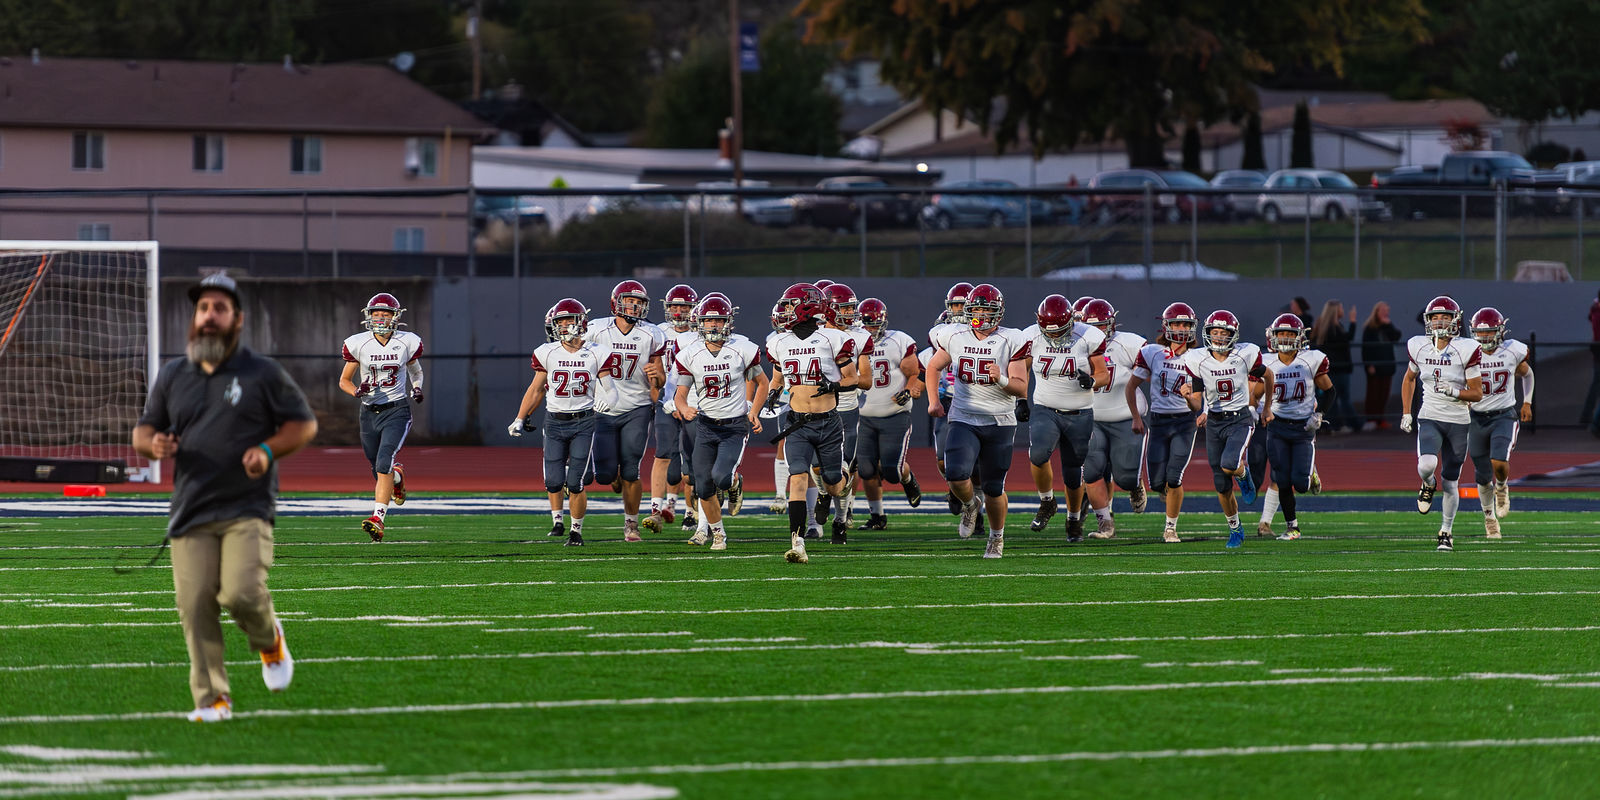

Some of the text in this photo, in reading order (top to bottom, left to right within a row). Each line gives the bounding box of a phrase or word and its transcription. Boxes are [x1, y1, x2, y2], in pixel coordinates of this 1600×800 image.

[612, 342, 637, 350] TROJANS
[964, 346, 992, 354] TROJANS
[1046, 346, 1072, 354] TROJANS
[788, 347, 816, 356] TROJANS
[370, 353, 399, 361] TROJANS
[558, 360, 585, 368] TROJANS
[610, 352, 641, 381] 87
[1162, 362, 1187, 371] TROJAN
[1425, 358, 1452, 366] TROJANS
[1479, 361, 1505, 369] TROJANS
[703, 363, 730, 372] TROJANS
[783, 356, 823, 386] 34
[958, 355, 997, 386] 65
[1038, 355, 1078, 381] 74
[1210, 367, 1237, 376] TROJANS
[368, 363, 400, 388] 13
[1275, 371, 1301, 380] TROJANS
[551, 369, 592, 398] 23
[1159, 370, 1189, 397] 14
[1432, 367, 1442, 394] 1
[1215, 377, 1235, 401] 9
[1273, 379, 1307, 404] 24
